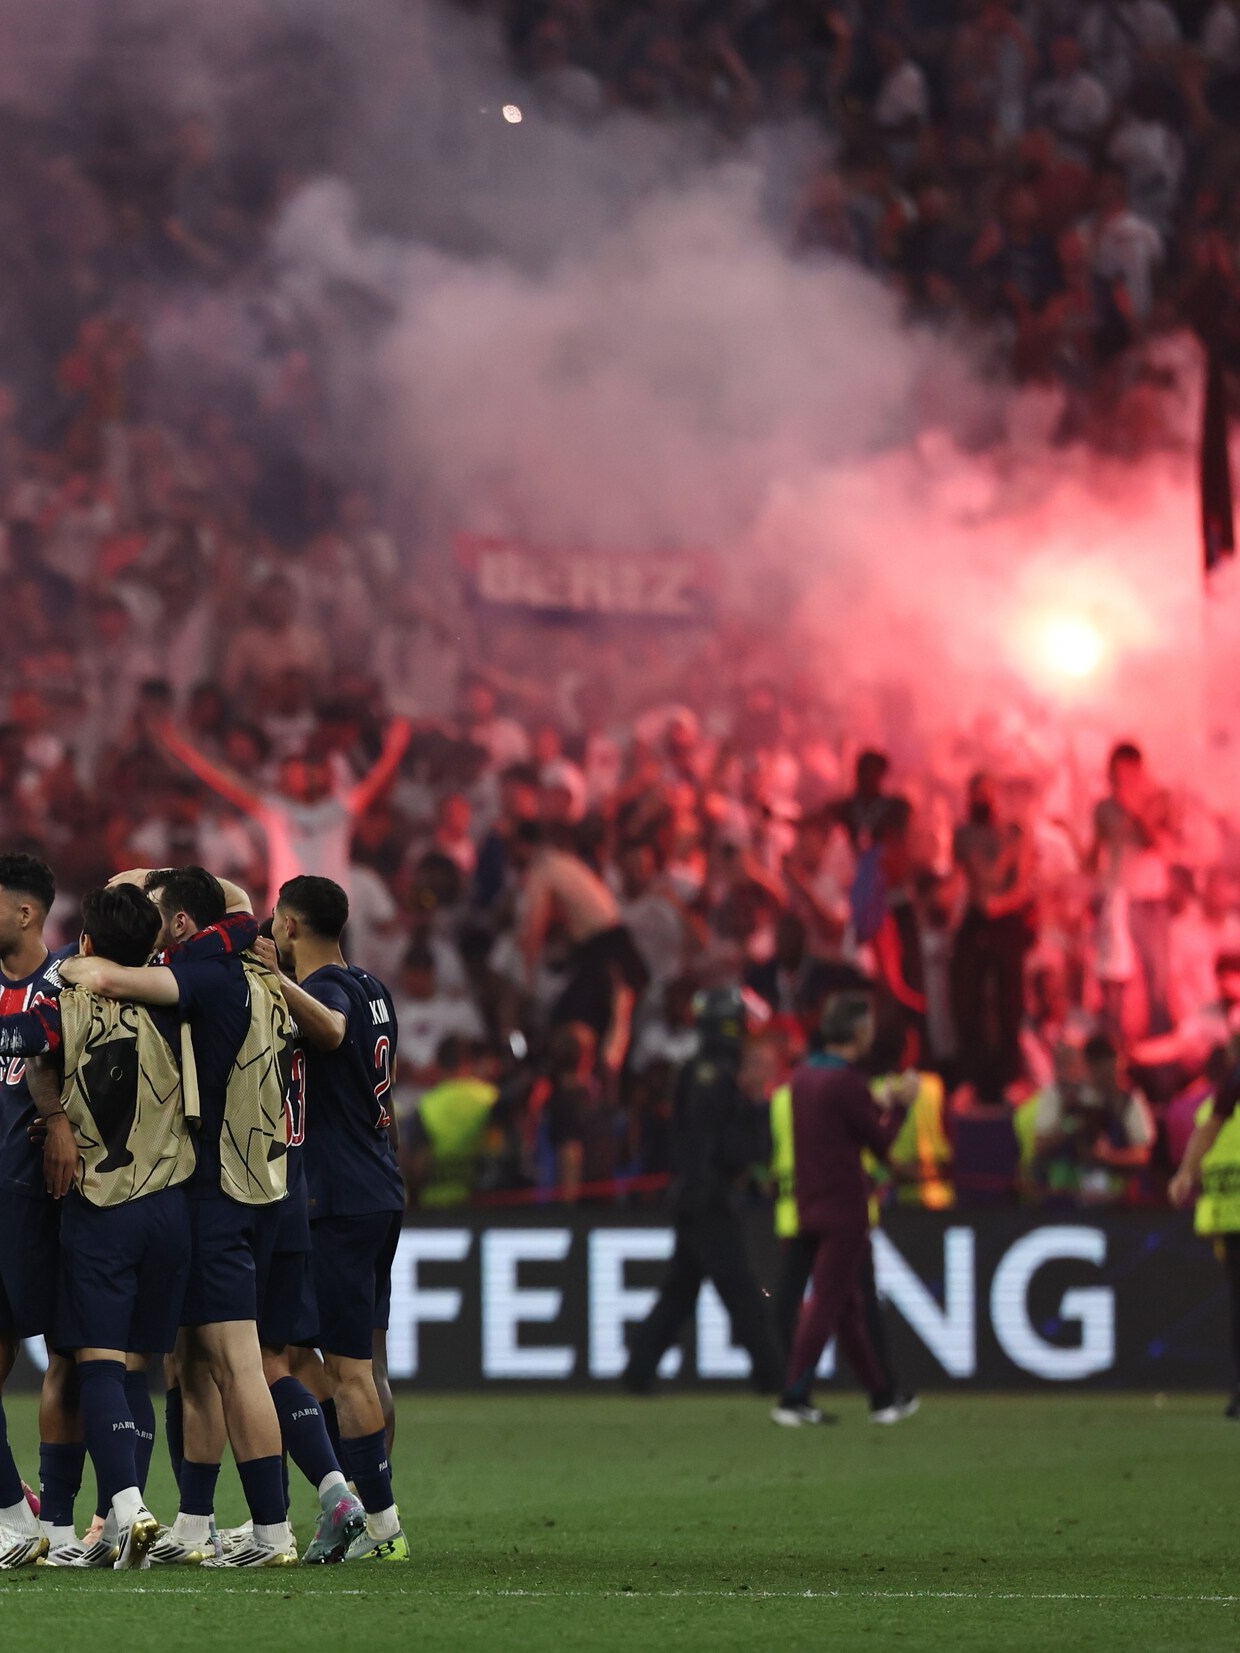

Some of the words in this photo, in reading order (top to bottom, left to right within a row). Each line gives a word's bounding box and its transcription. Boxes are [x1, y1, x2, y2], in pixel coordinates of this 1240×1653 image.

[387, 1225, 1116, 1381] FEELNG
[291, 1407, 319, 1421] PARIS
[112, 1421, 136, 1431] PARIS
[135, 1429, 153, 1440] ARIS
